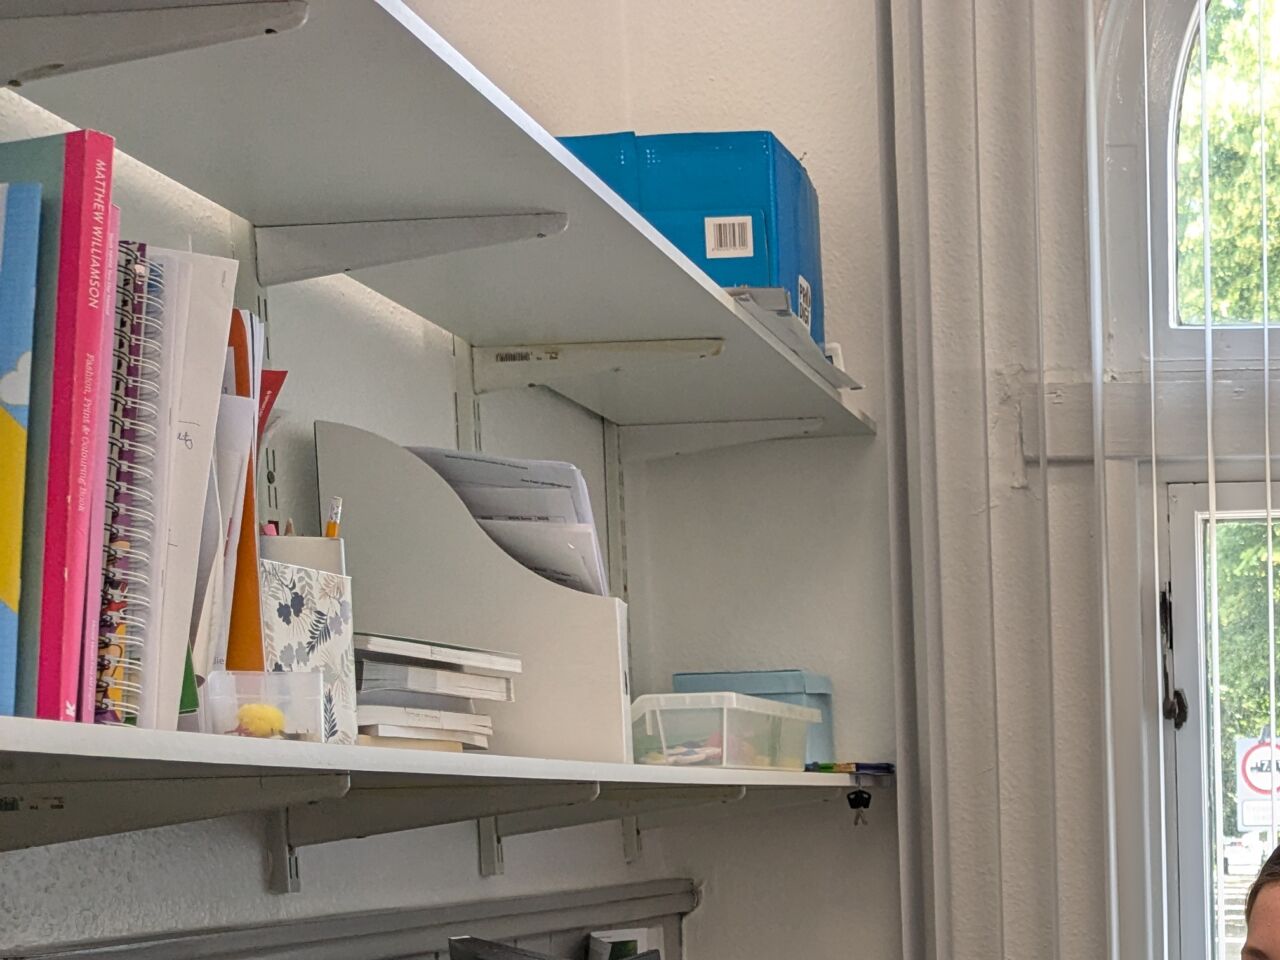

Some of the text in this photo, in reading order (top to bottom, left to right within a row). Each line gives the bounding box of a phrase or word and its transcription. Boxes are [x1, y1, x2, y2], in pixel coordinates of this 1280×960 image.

[88, 158, 107, 309] MATTHEW WILLIAMSON
[83, 353, 95, 395] Fashion,
[81, 397, 93, 424] Print
